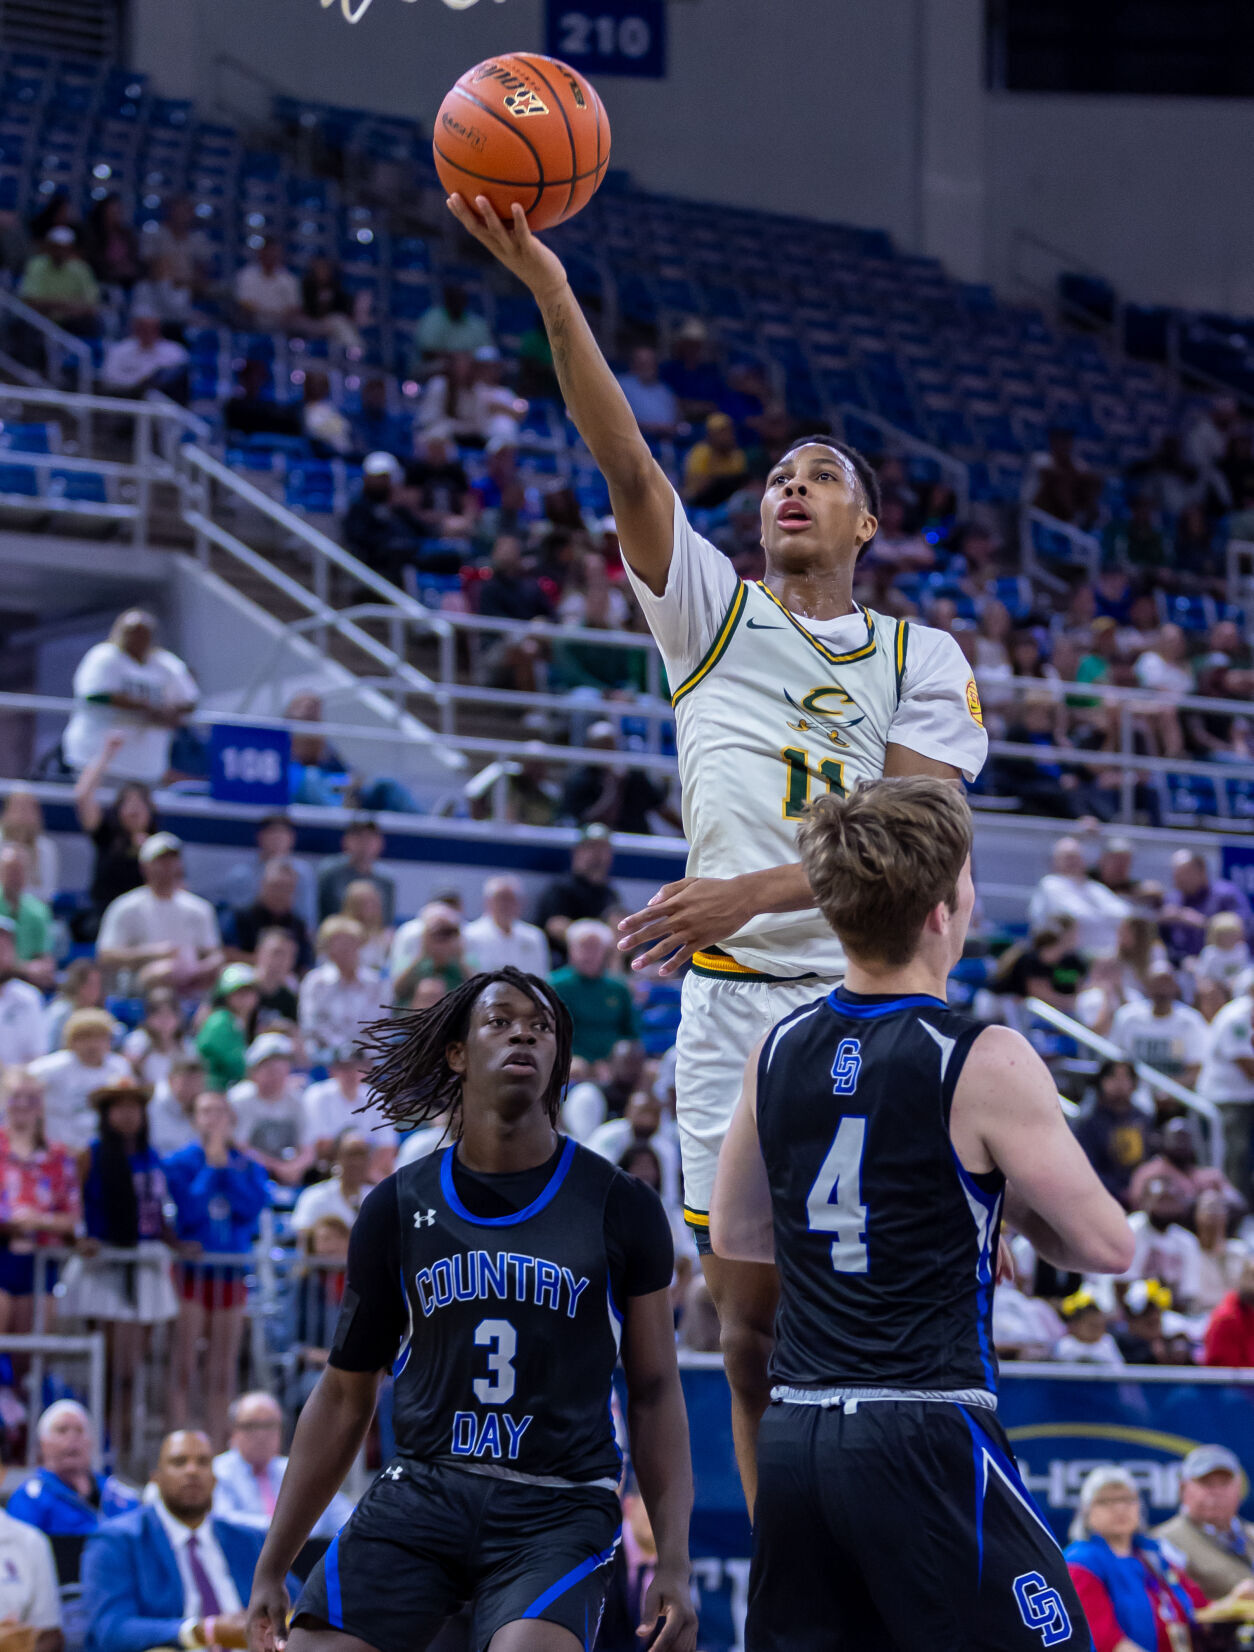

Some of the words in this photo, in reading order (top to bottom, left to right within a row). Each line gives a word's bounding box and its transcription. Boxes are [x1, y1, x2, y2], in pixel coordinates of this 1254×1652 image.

[559, 12, 651, 58] 210
[805, 1114, 870, 1276] 4
[415, 1250, 590, 1318] COUNTRY
[472, 1318, 518, 1405] 3
[451, 1411, 534, 1459] DAY
